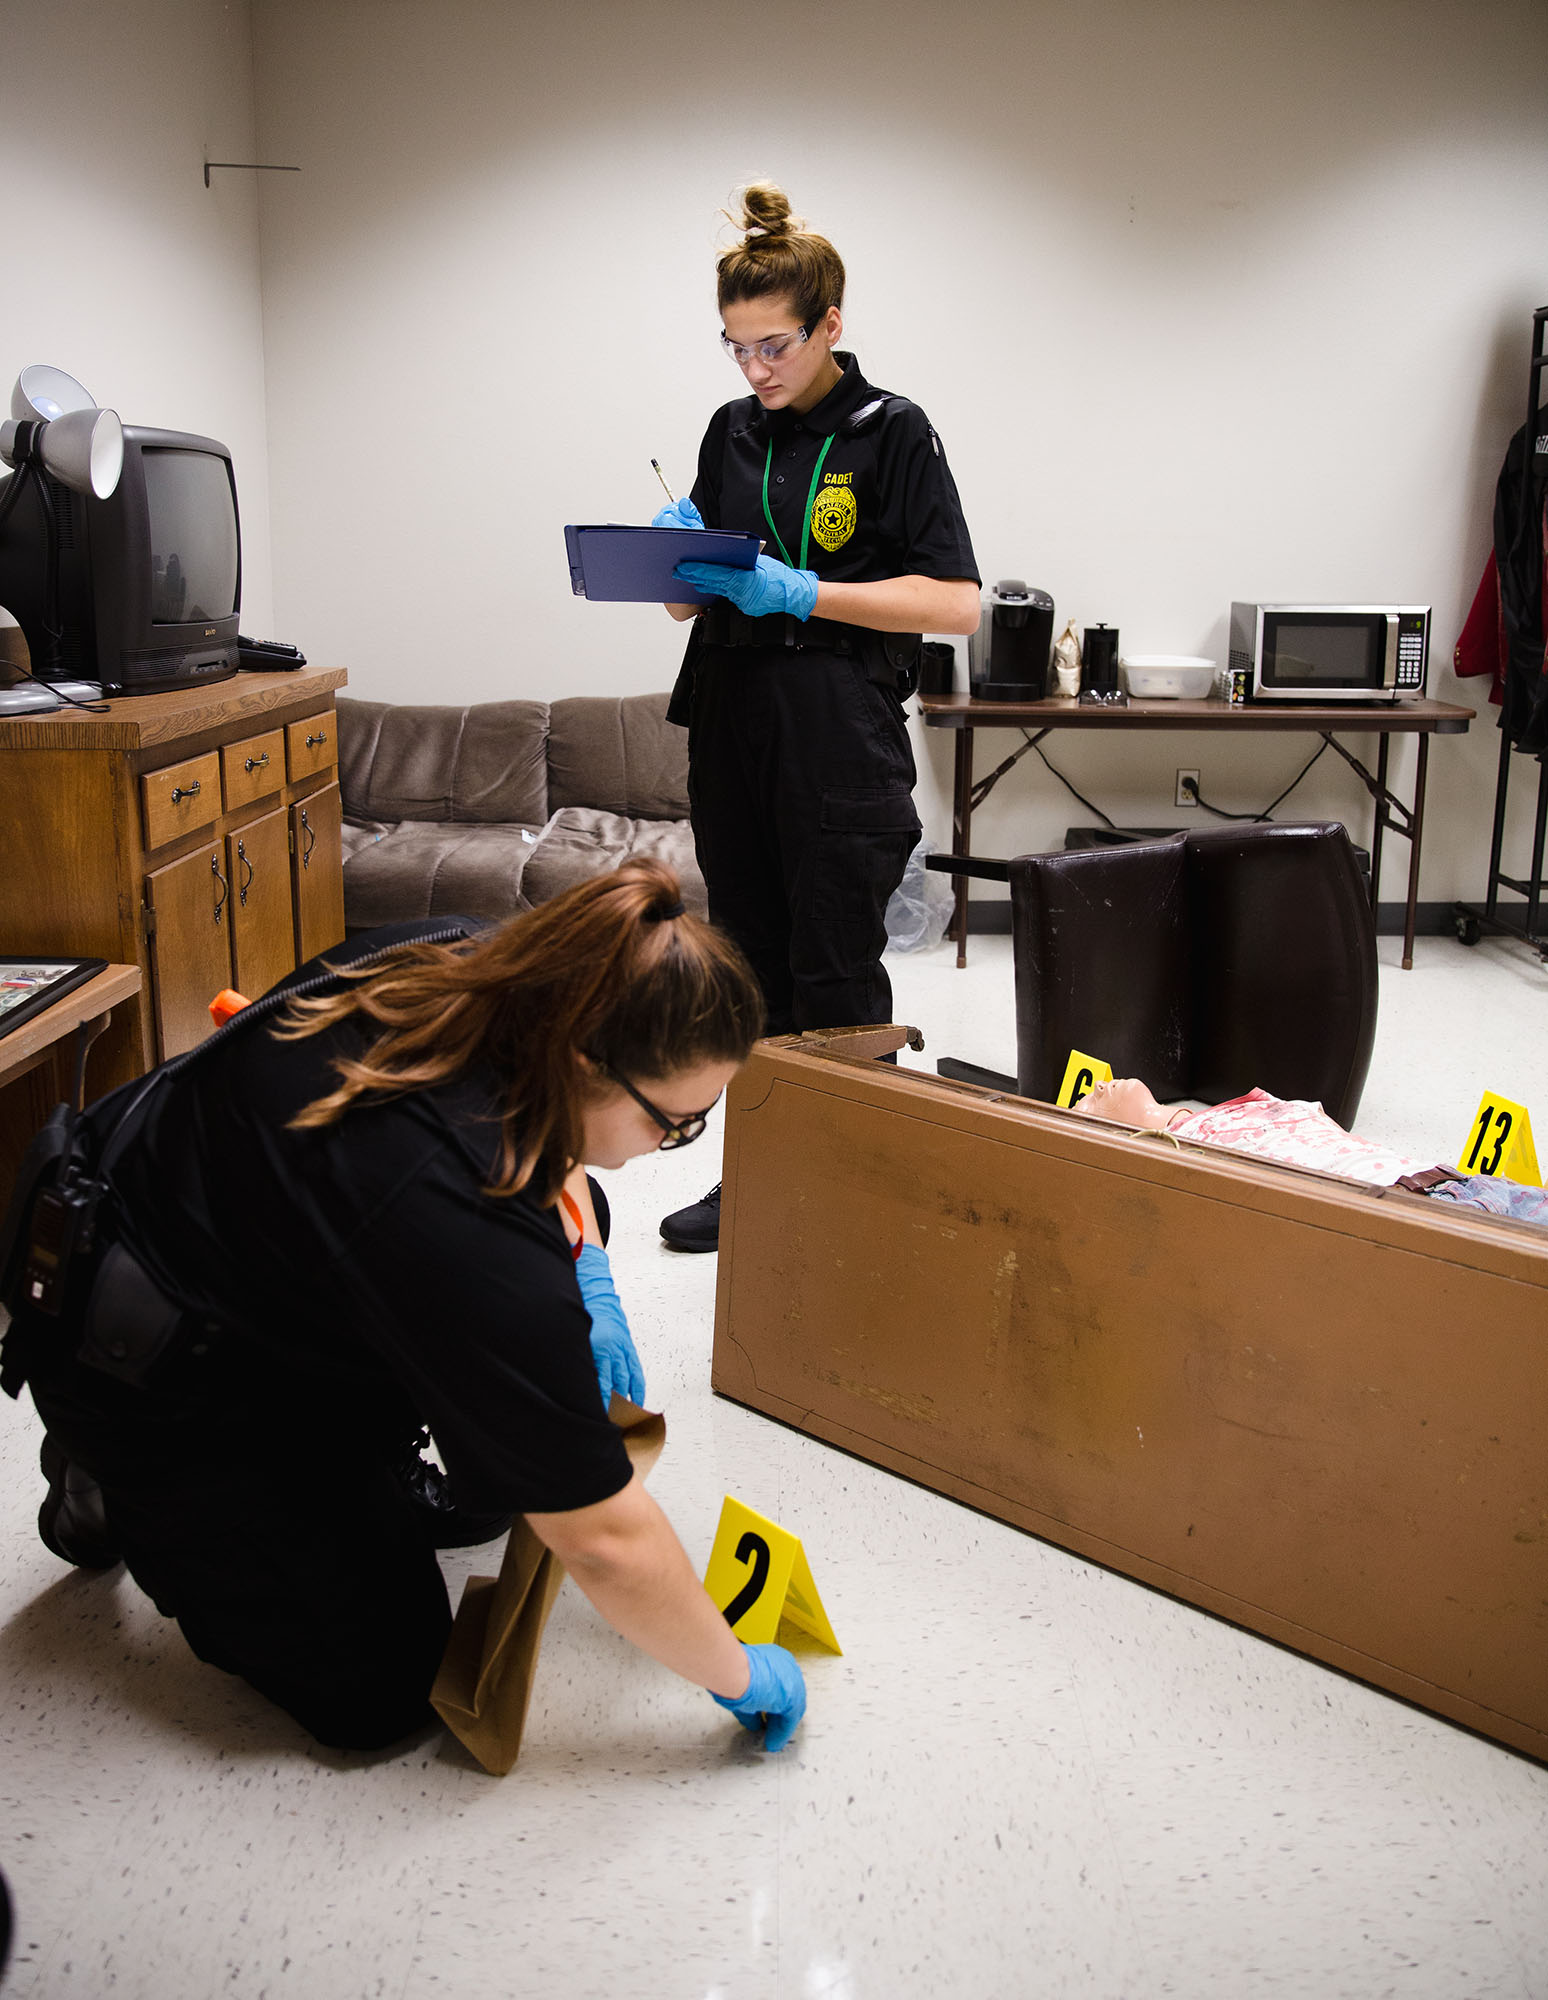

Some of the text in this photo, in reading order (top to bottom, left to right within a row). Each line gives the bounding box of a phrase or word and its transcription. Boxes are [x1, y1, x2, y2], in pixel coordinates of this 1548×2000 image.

[824, 472, 854, 485] CADET
[820, 502, 849, 514] PATROL
[1068, 1068, 1093, 1109] 6
[1467, 1105, 1512, 1176] 13
[722, 1531, 770, 1644] 2
